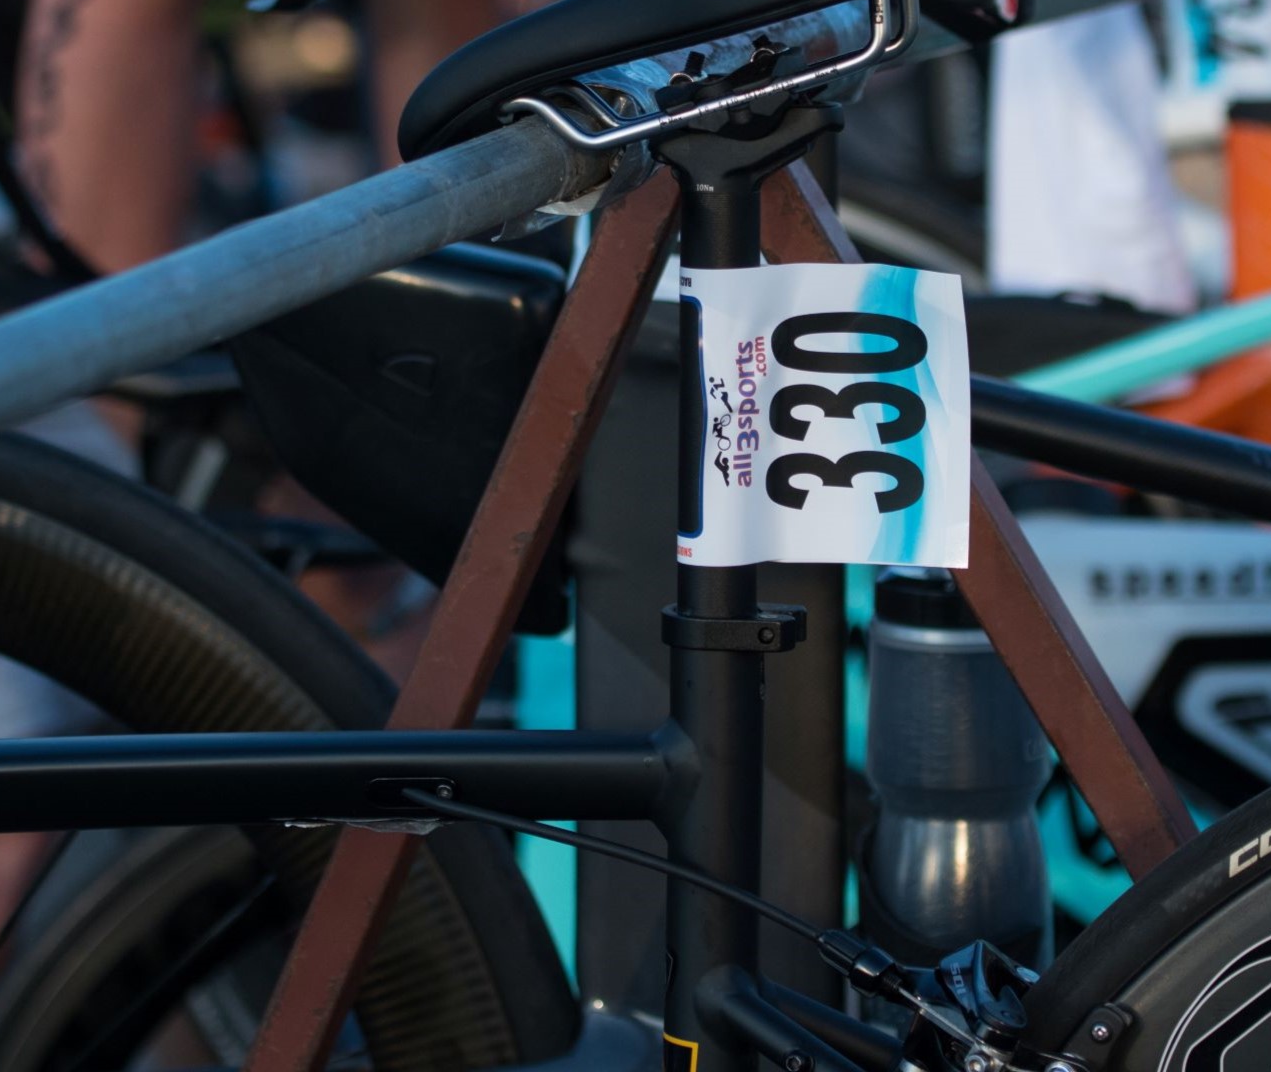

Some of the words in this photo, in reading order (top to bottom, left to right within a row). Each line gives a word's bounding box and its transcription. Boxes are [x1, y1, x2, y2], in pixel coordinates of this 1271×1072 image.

[733, 341, 760, 488] all3sports
[755, 336, 767, 376] .com
[765, 311, 928, 514] 330
